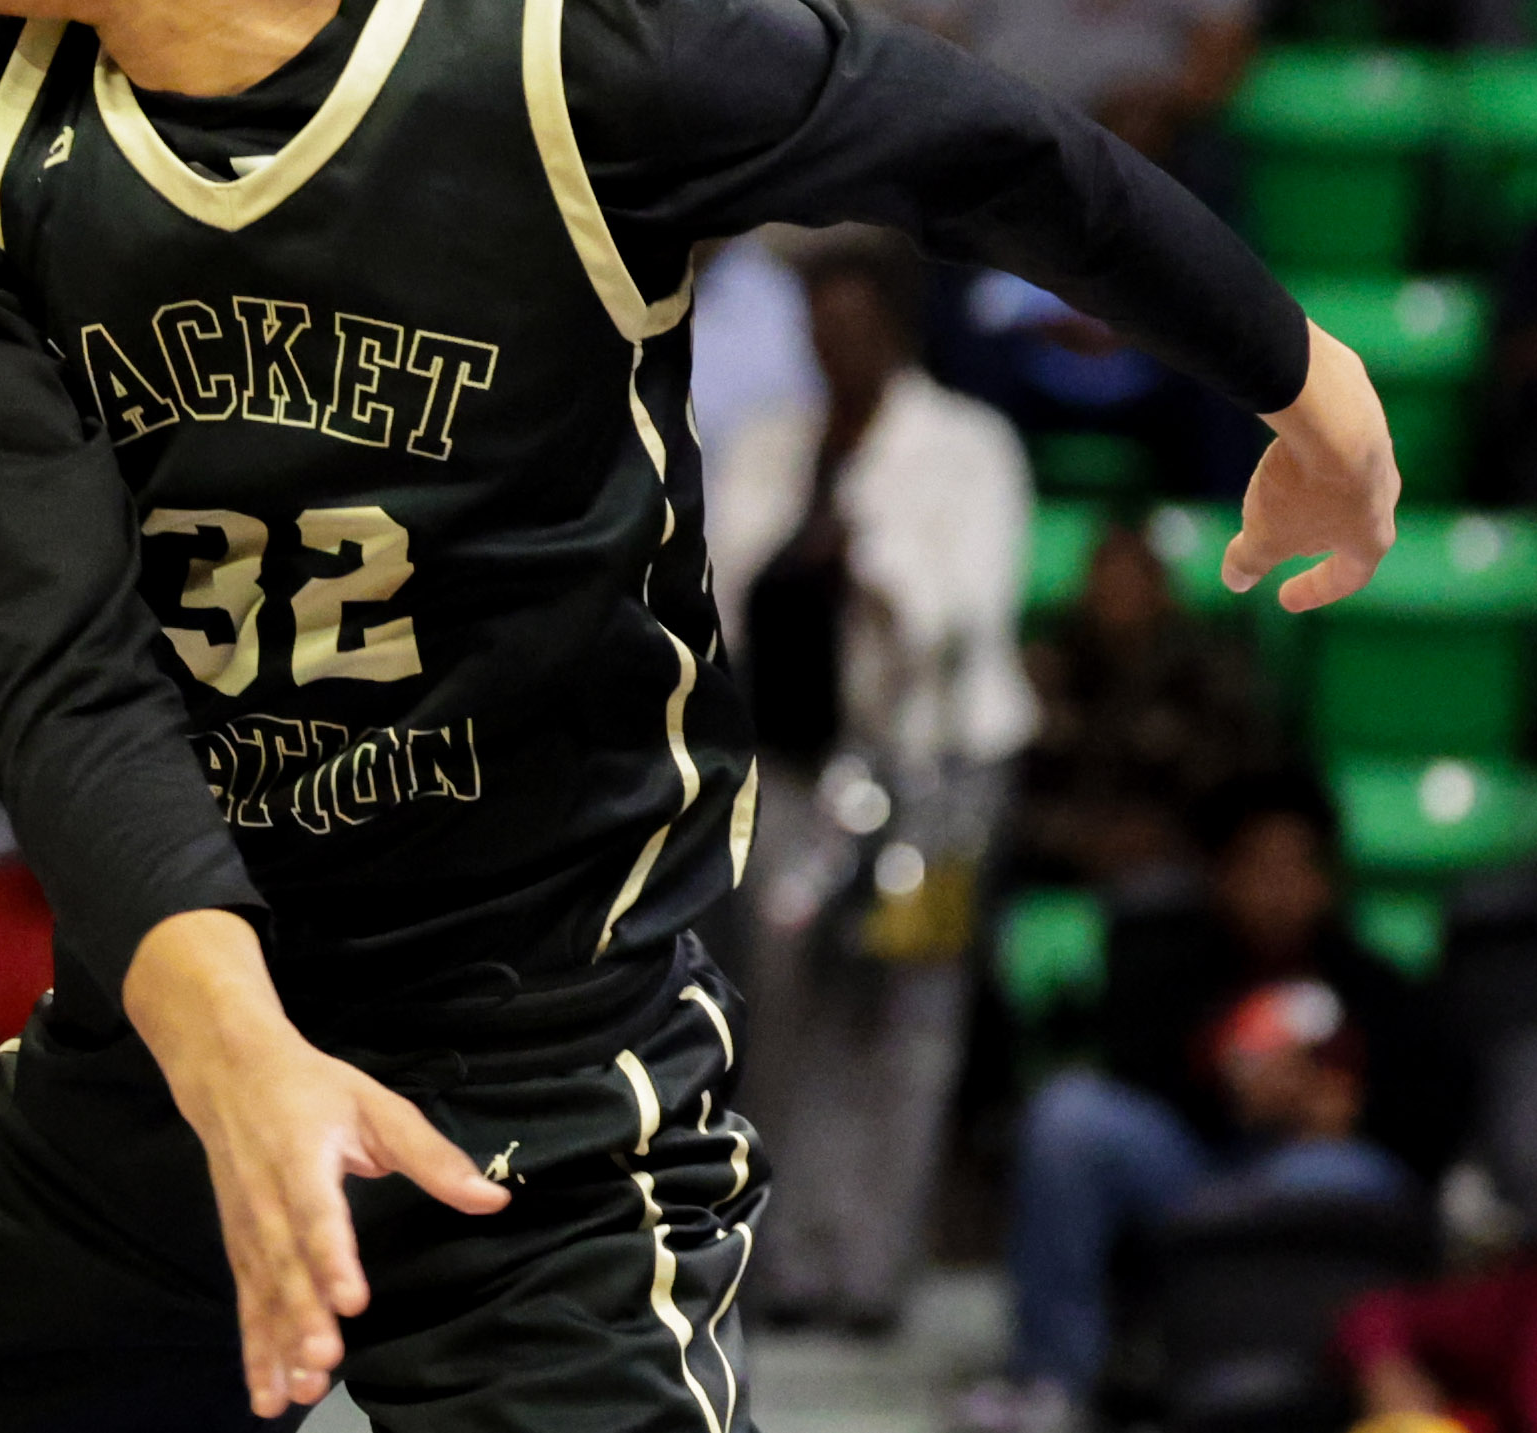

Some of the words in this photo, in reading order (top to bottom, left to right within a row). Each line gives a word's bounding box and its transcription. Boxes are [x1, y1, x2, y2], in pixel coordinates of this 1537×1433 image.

[47, 295, 499, 461] ACKET
[140, 506, 423, 697] 32
[183, 712, 482, 835] ATION
